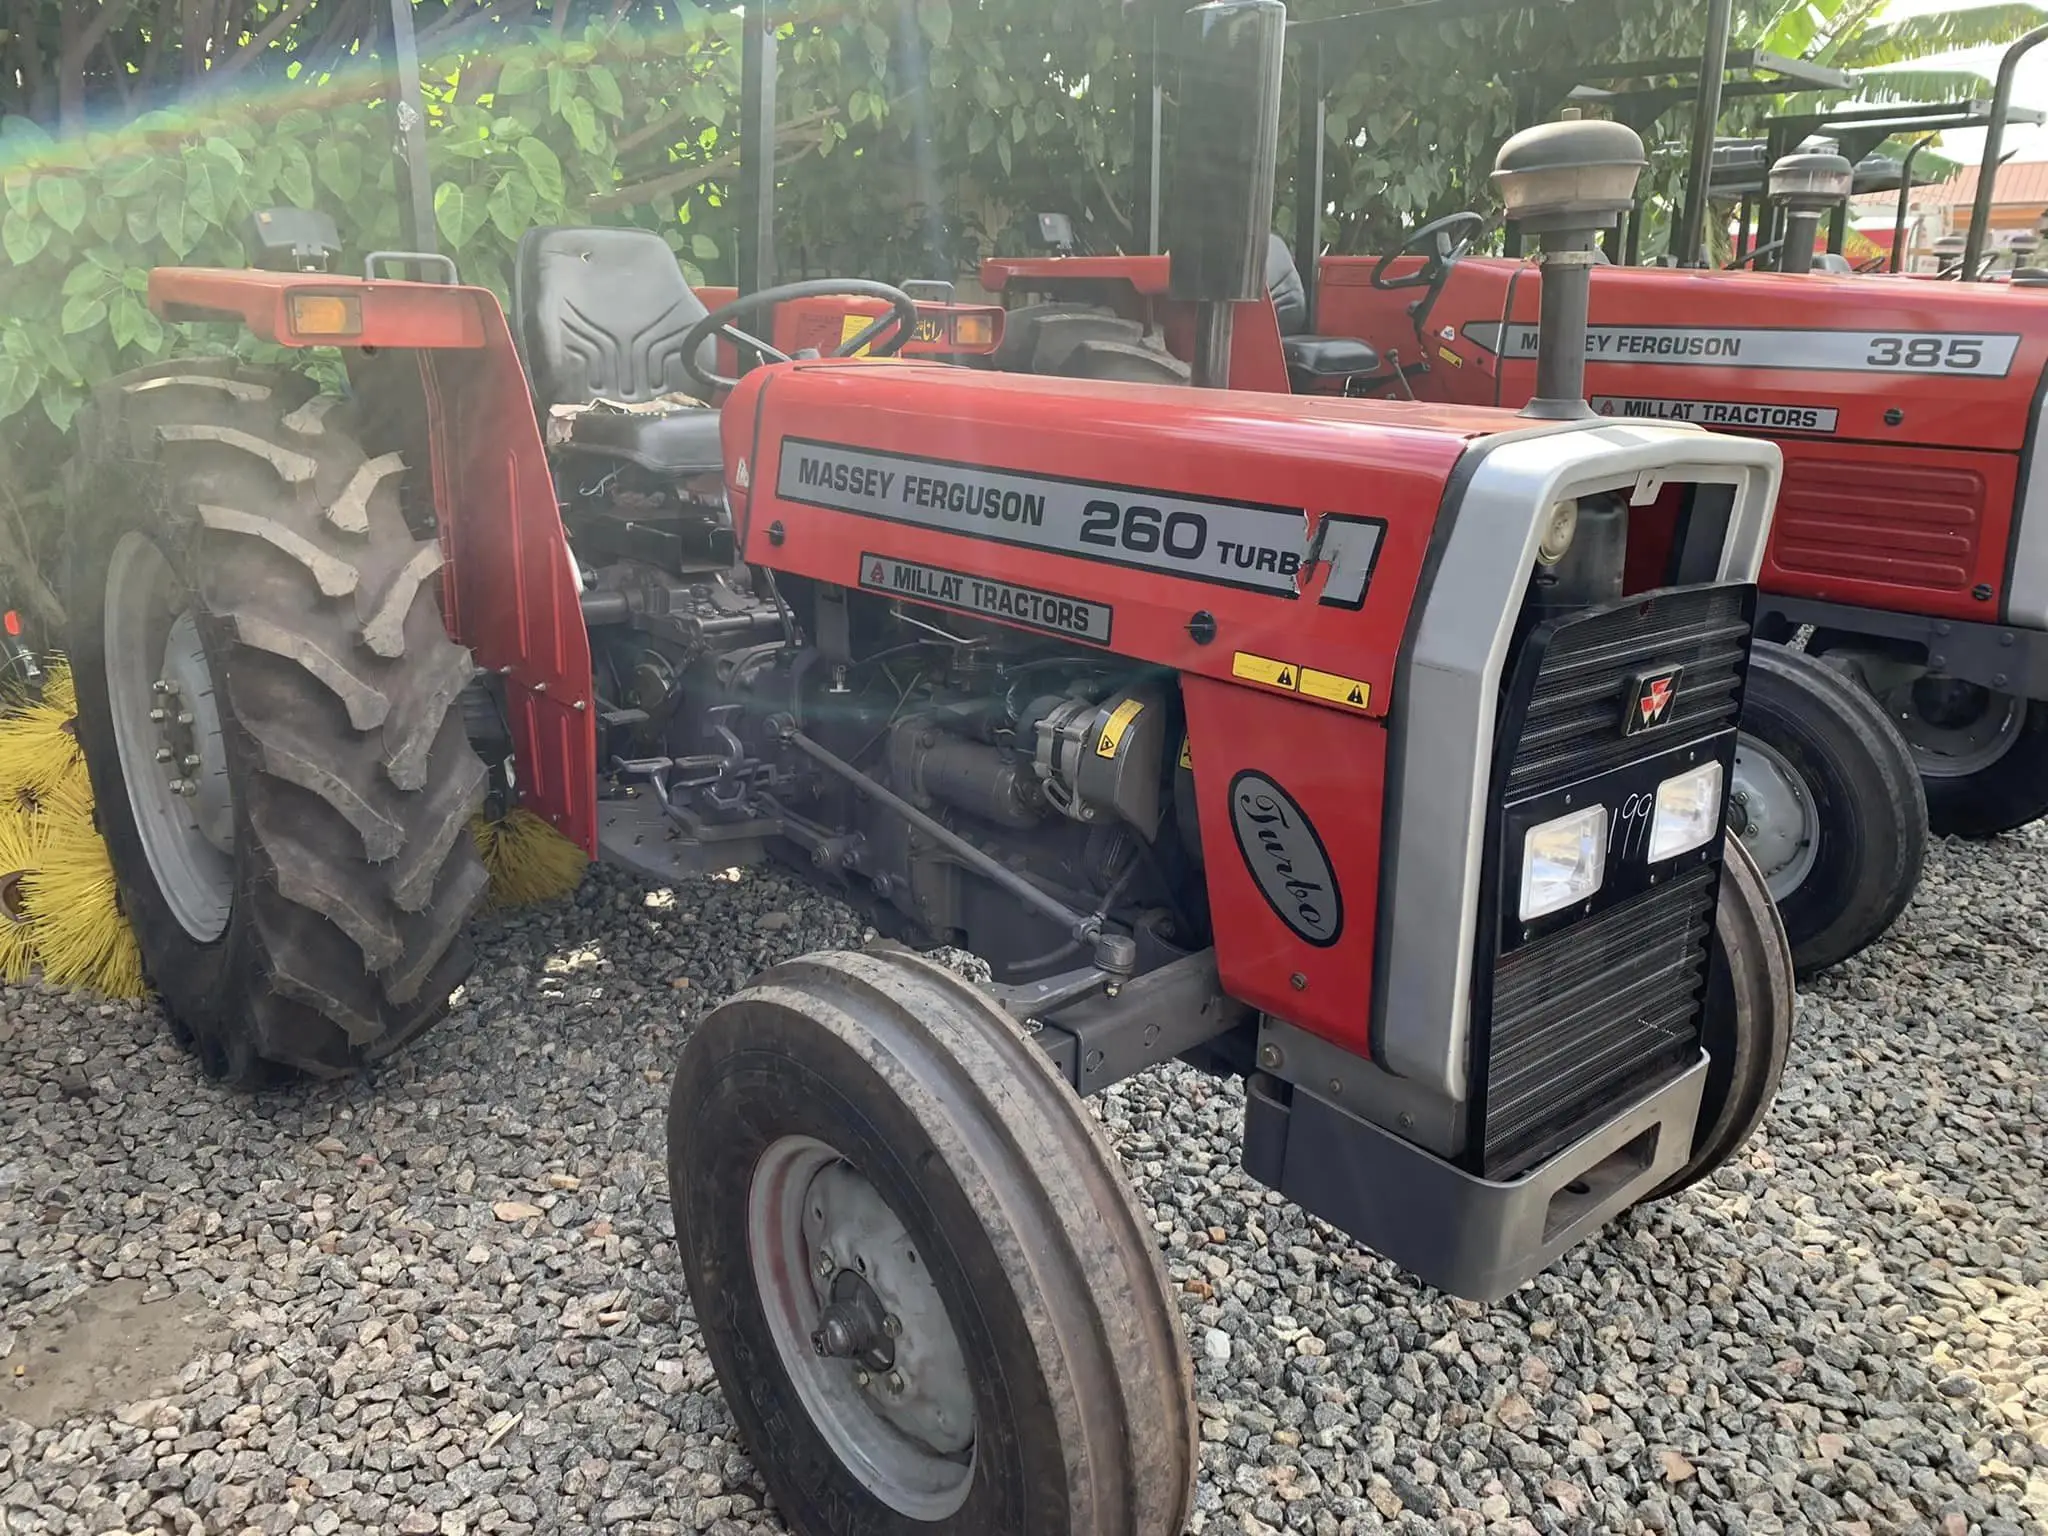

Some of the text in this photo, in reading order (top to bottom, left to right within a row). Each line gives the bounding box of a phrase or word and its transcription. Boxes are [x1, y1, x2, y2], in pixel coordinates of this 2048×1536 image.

[1520, 333, 1984, 369] MEY FERGUSON 385
[1623, 400, 1818, 428] MILLAT TRACTORS
[798, 457, 1301, 576] MASSEY FERGUSON 260 TURB
[893, 565, 1090, 632] MILLAT TRACTORS
[1607, 792, 1653, 860] 199
[1240, 793, 1326, 934] Turbo
